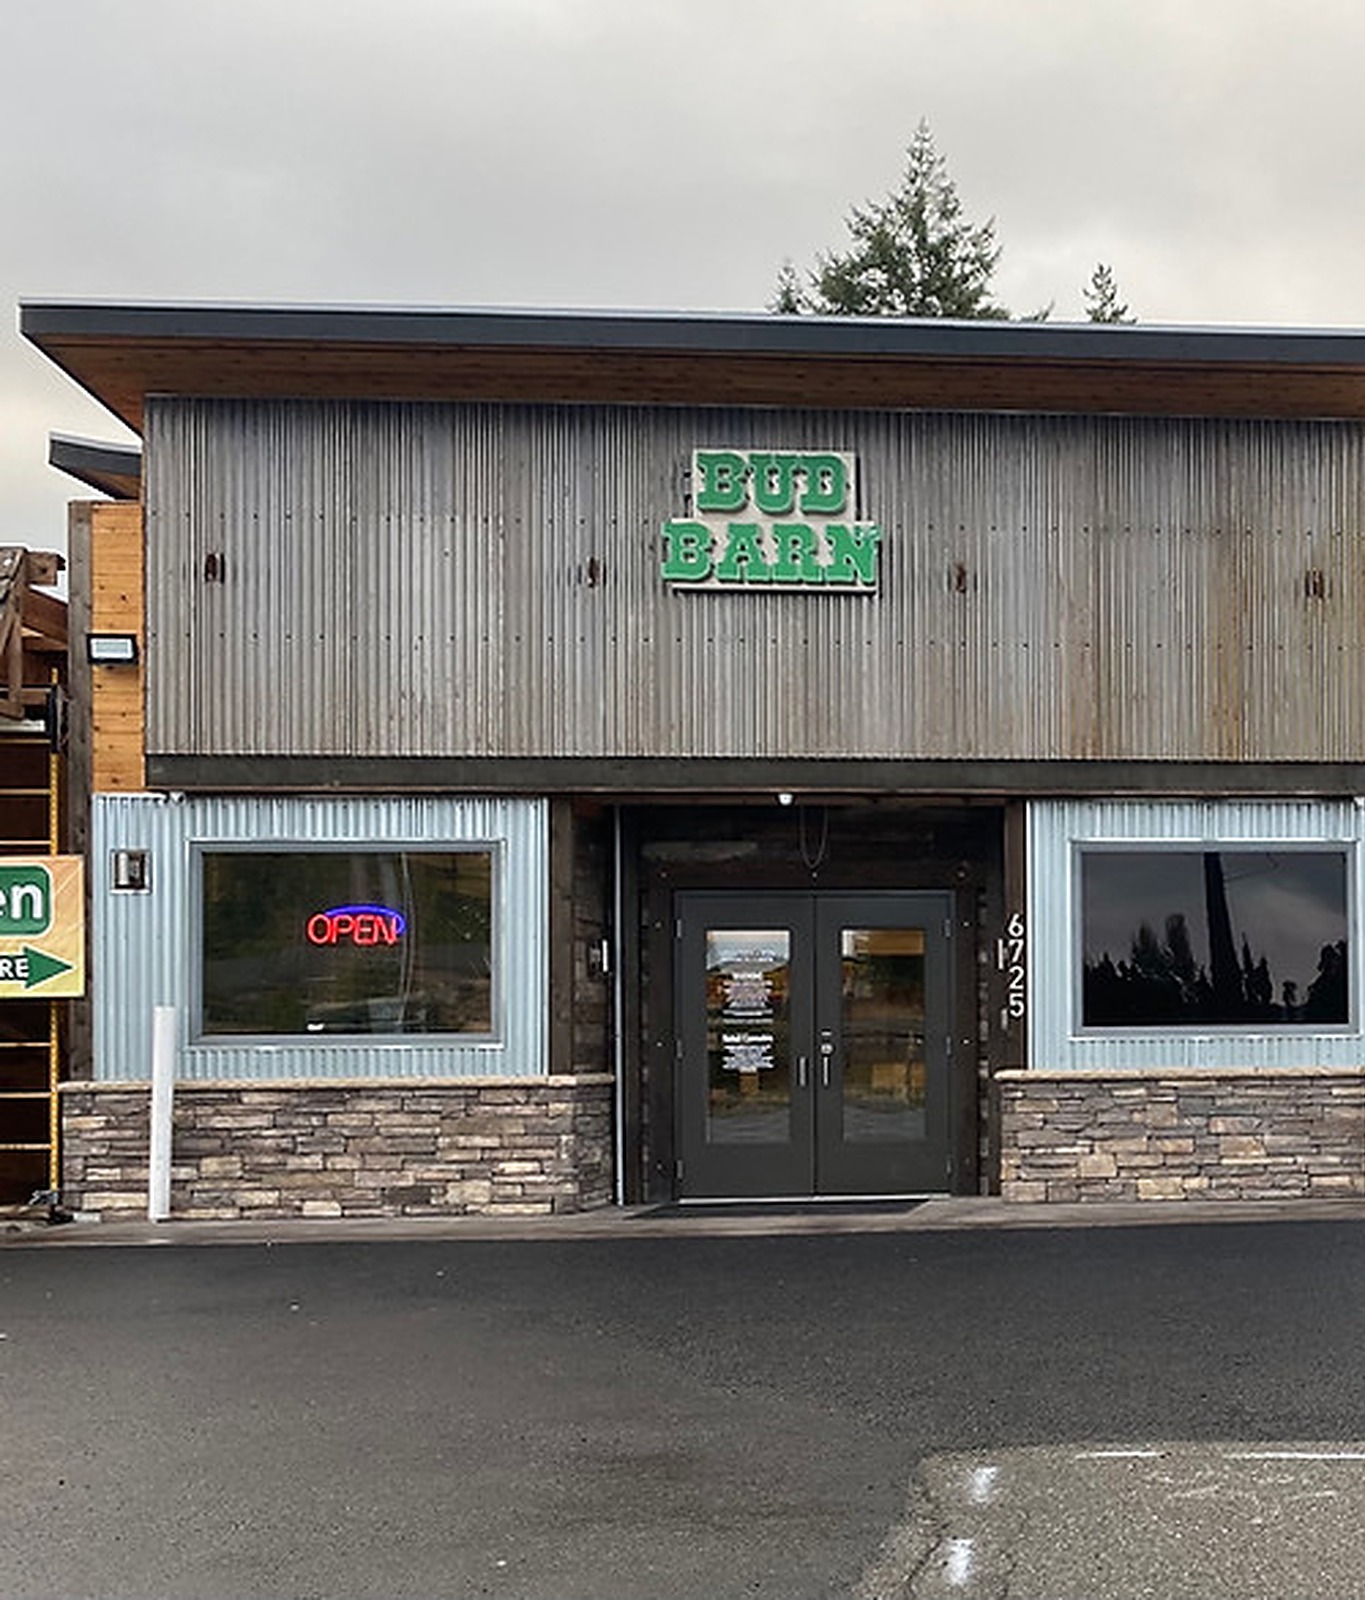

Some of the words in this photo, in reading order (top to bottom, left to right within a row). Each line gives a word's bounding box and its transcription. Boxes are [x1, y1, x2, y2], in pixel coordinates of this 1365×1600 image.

[696, 452, 847, 515] BUD
[661, 520, 881, 585] BARN
[307, 913, 398, 945] OPEN
[1008, 913, 1025, 1018] 6725
